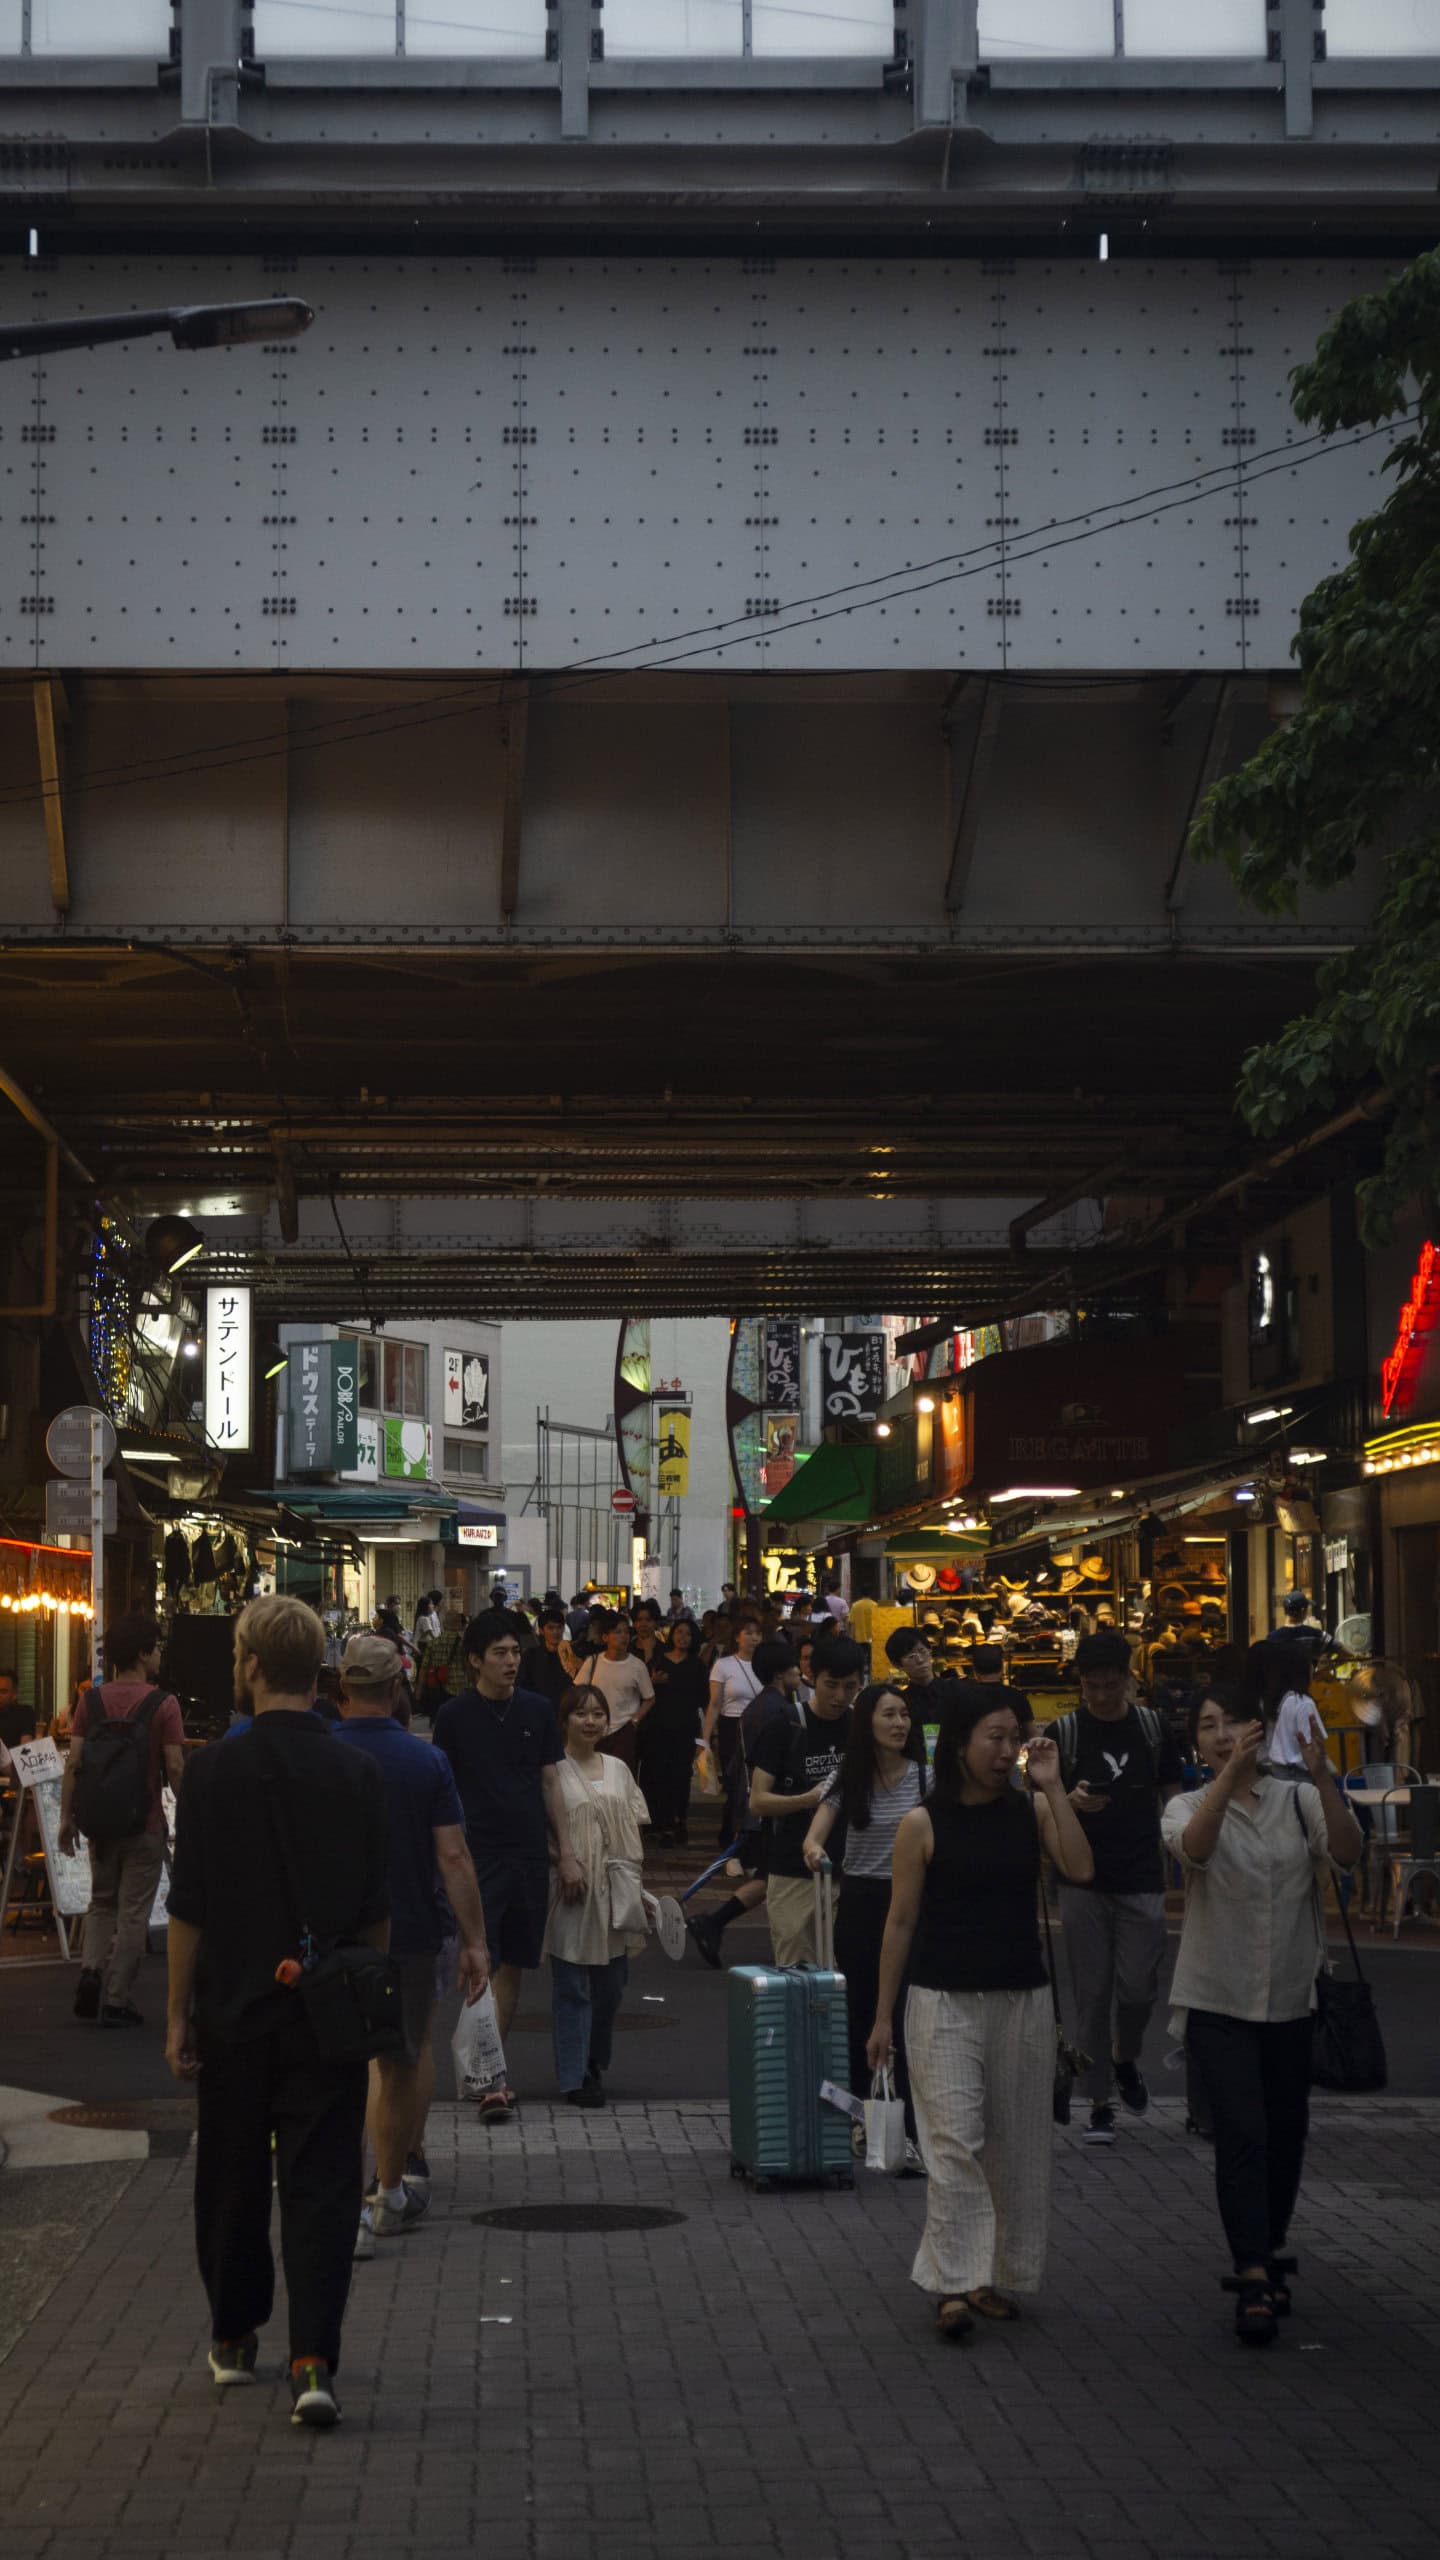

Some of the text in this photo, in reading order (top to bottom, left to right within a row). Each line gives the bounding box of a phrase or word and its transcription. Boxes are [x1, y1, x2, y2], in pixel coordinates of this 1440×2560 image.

[217, 1297, 239, 1441] サテンドール
[337, 1409, 345, 1445] TAILOR
